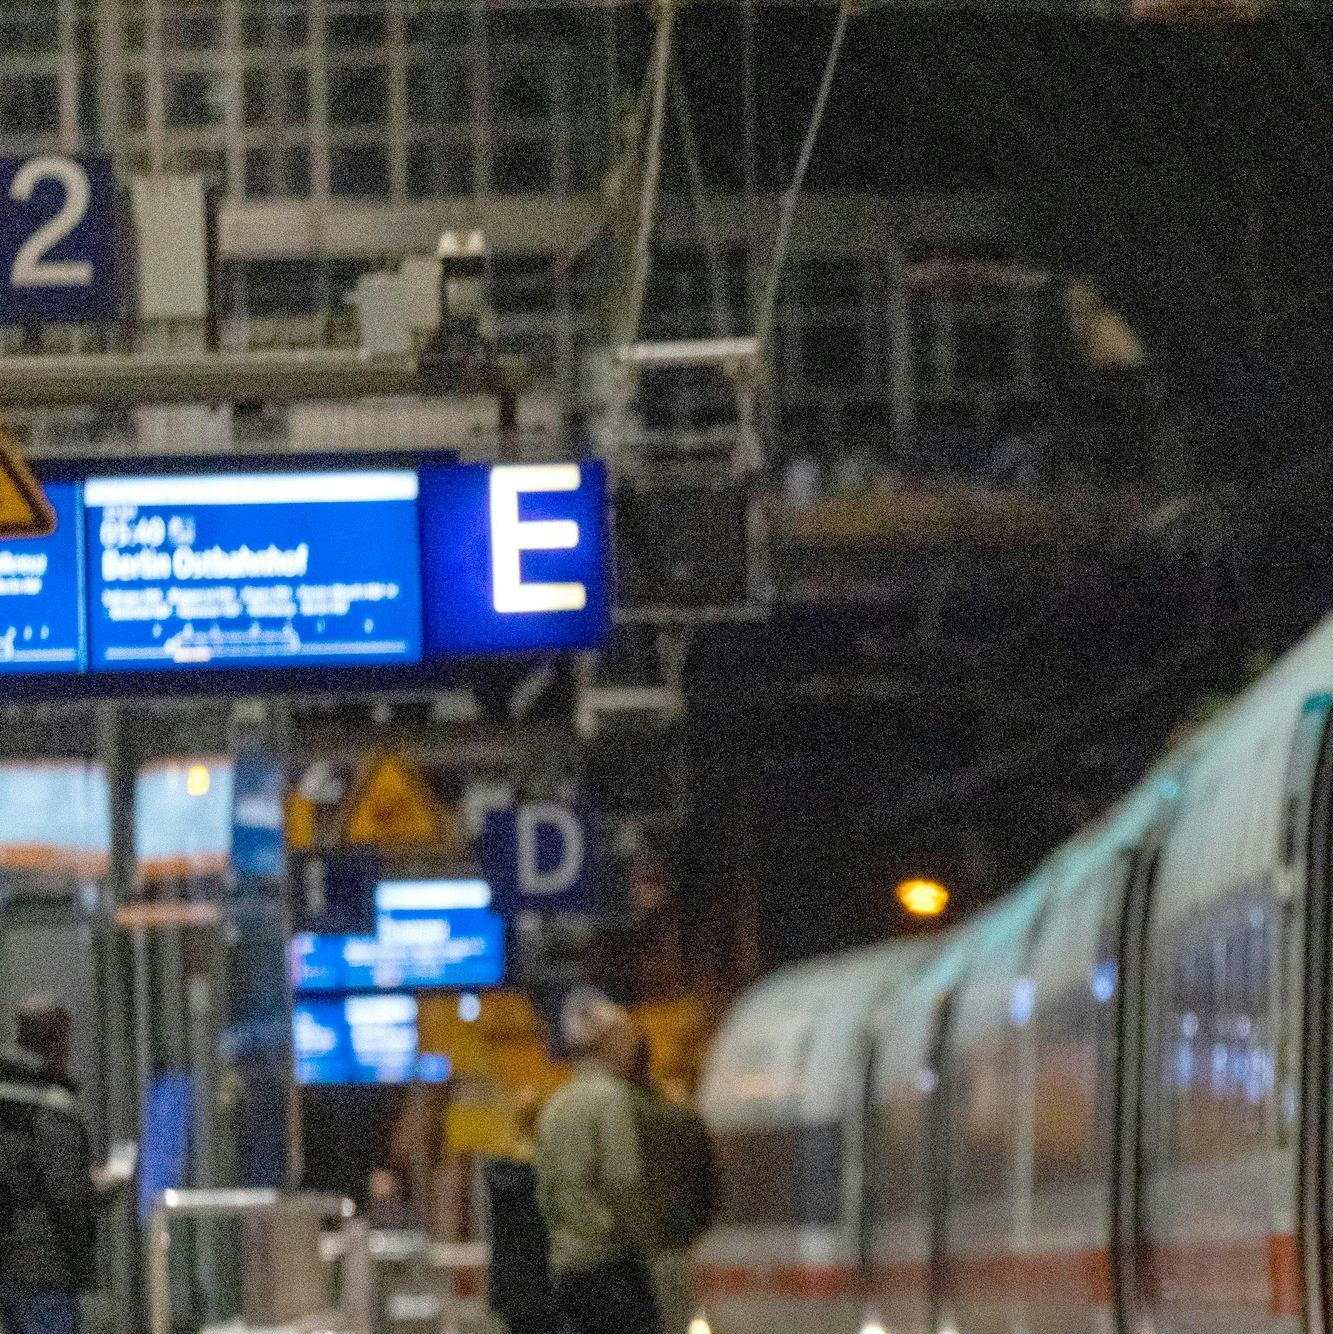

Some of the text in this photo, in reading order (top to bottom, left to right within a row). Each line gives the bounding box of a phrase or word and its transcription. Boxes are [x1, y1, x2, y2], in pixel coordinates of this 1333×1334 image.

[9, 156, 94, 288] 2
[490, 463, 587, 614] E
[516, 804, 586, 896] D
